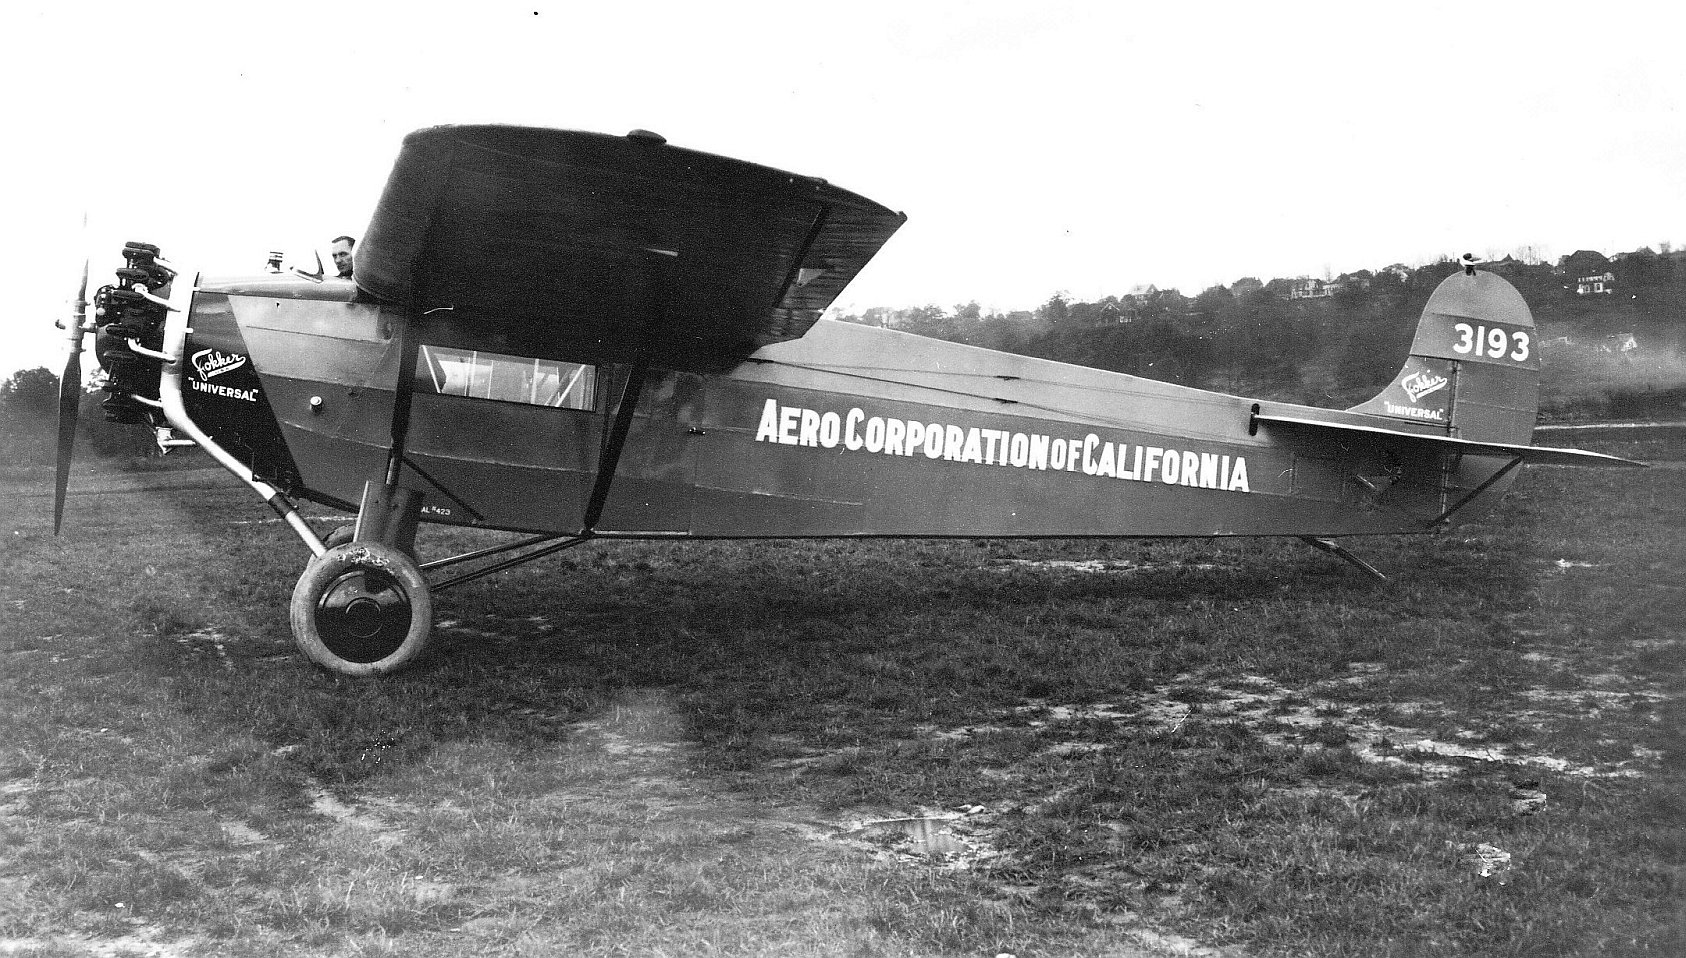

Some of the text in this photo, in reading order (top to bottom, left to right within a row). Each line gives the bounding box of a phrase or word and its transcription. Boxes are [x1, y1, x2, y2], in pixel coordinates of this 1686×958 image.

[1453, 323, 1530, 362] 3193
[192, 348, 246, 381] Fokker
[1401, 371, 1448, 403] Fokker
[755, 398, 1250, 493] AERO CORPORATION OF CALIFORNIA
